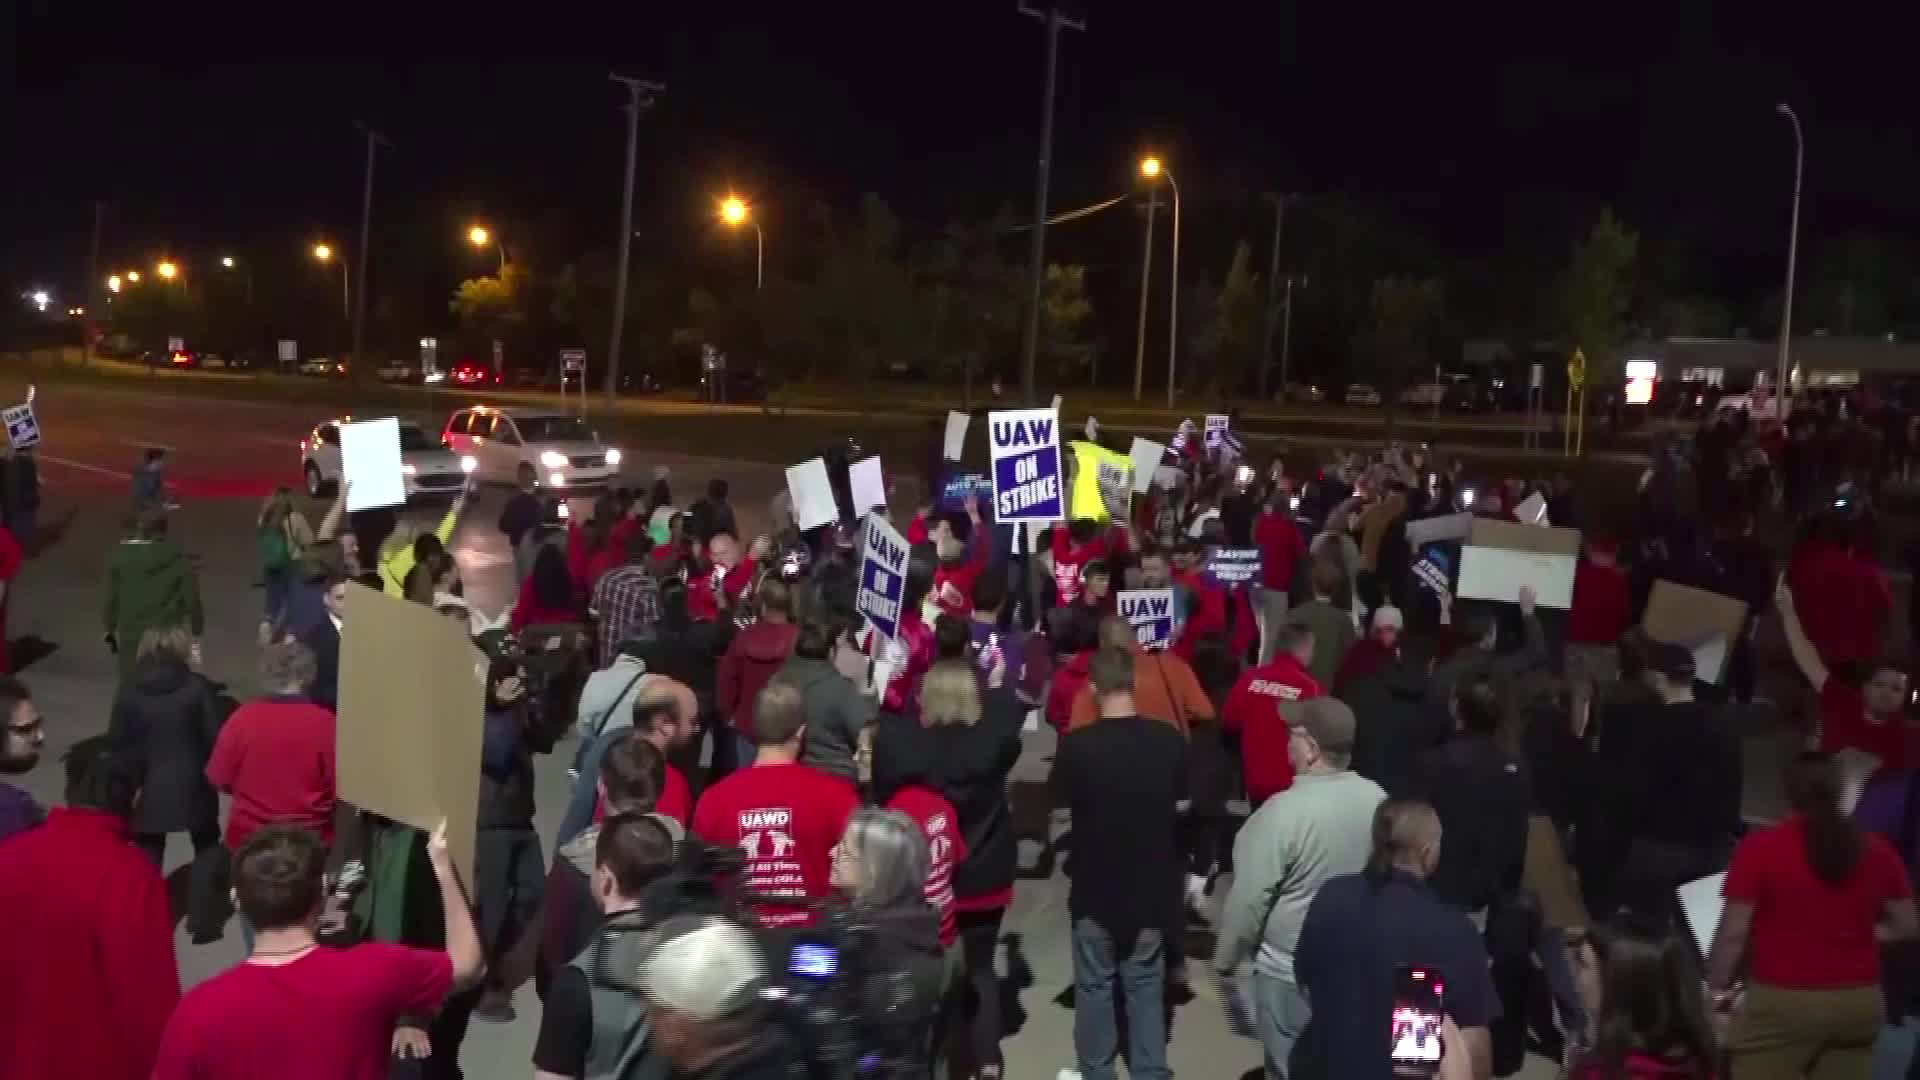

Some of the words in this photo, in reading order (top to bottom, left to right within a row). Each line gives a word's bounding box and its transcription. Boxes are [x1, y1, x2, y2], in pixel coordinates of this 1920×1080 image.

[993, 419, 1053, 446] UAW
[1015, 453, 1038, 484] ON
[999, 474, 1057, 515] STRIKE
[868, 522, 905, 572] UAW
[873, 569, 889, 595] ON
[1121, 597, 1169, 617] UAW
[741, 811, 789, 828] UAWD
